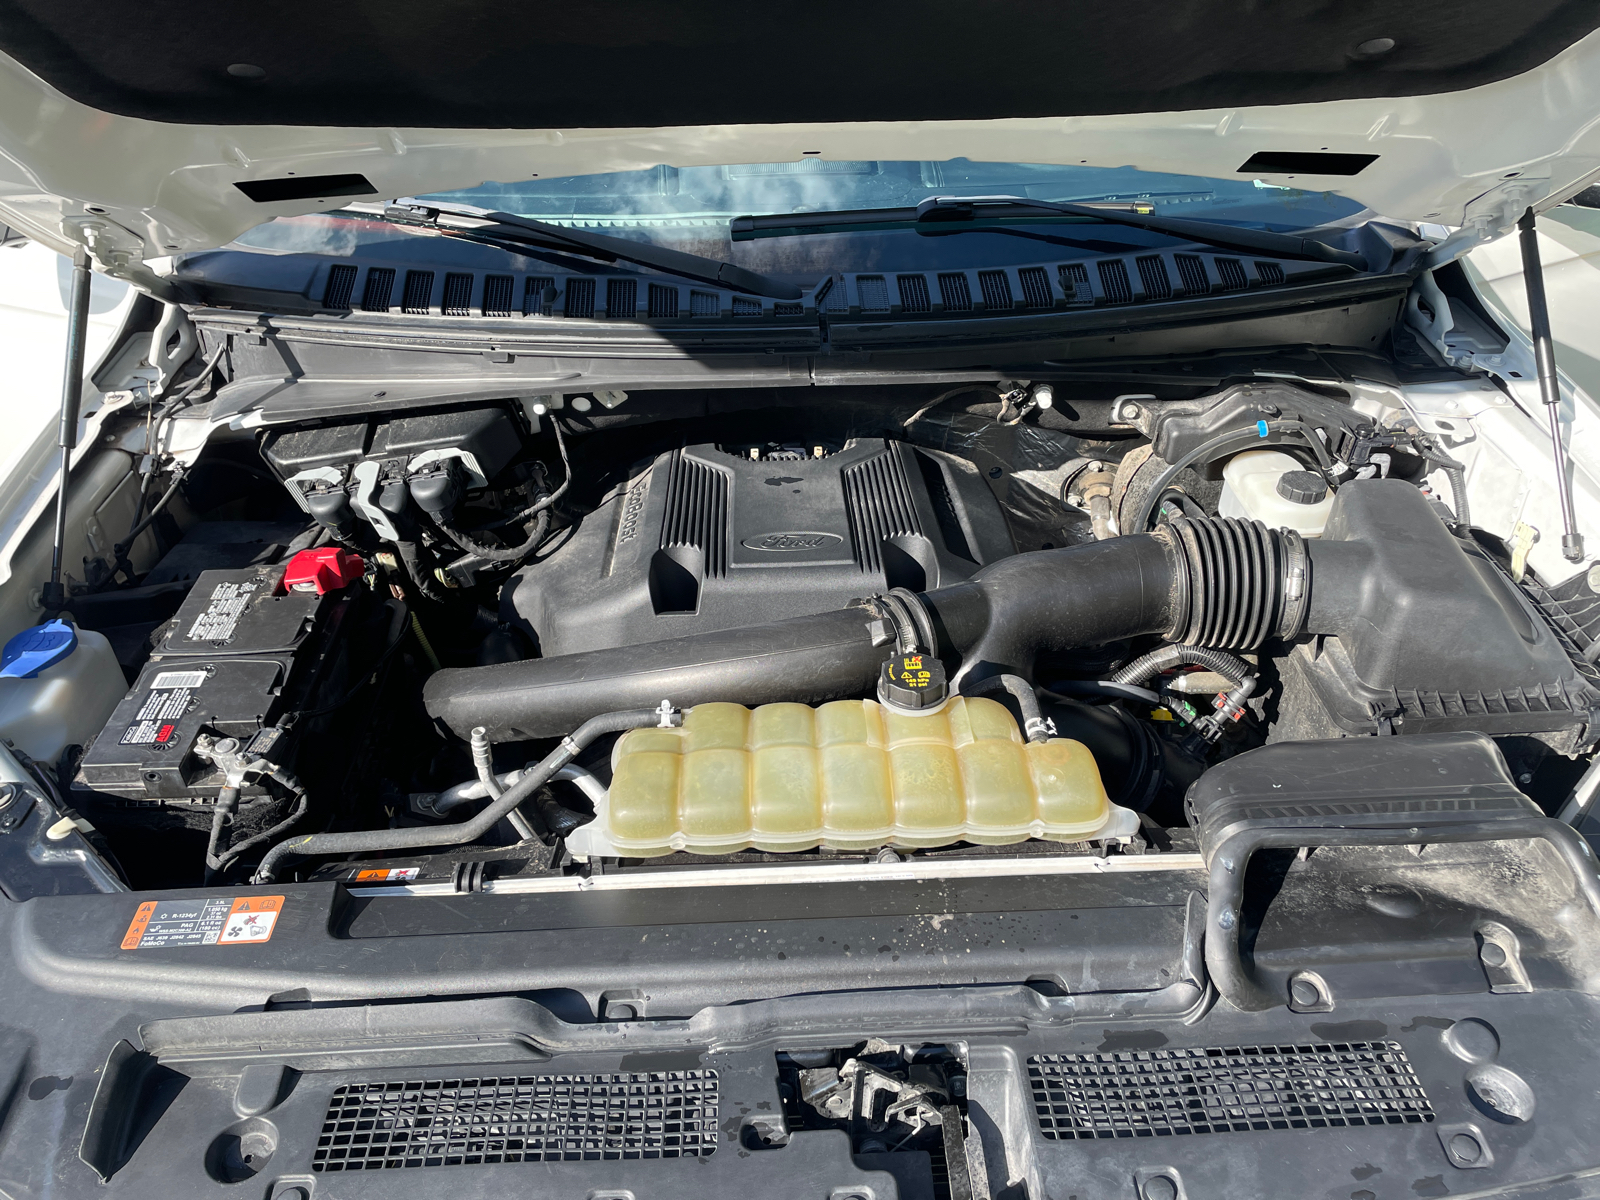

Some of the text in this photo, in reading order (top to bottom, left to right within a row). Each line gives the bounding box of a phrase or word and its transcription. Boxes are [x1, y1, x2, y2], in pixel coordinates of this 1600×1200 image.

[620, 481, 647, 545] EcoBoost
[760, 533, 825, 549] Ford
[155, 724, 173, 742] AGM
